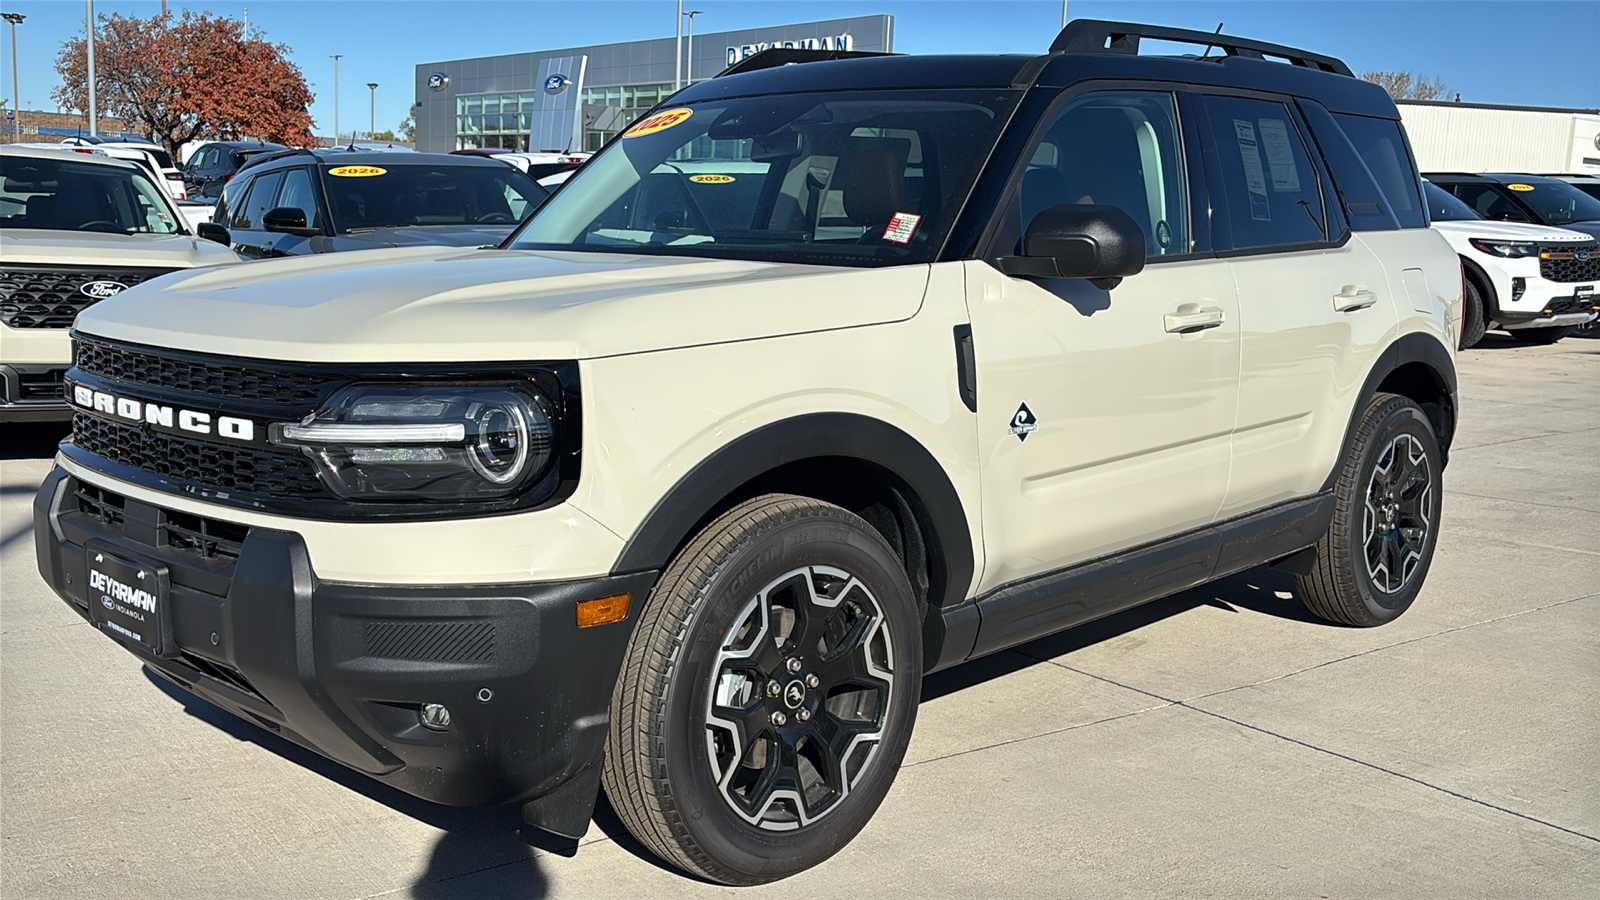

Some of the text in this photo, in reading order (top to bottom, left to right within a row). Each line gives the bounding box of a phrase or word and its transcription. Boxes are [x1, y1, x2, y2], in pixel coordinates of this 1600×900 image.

[726, 35, 848, 67] DEYMAN
[627, 112, 688, 134] 2025
[90, 283, 121, 296] Ford
[74, 385, 254, 441] BRONCO
[90, 569, 156, 614] DEYARMAN
[115, 603, 145, 622] INDIANOLA
